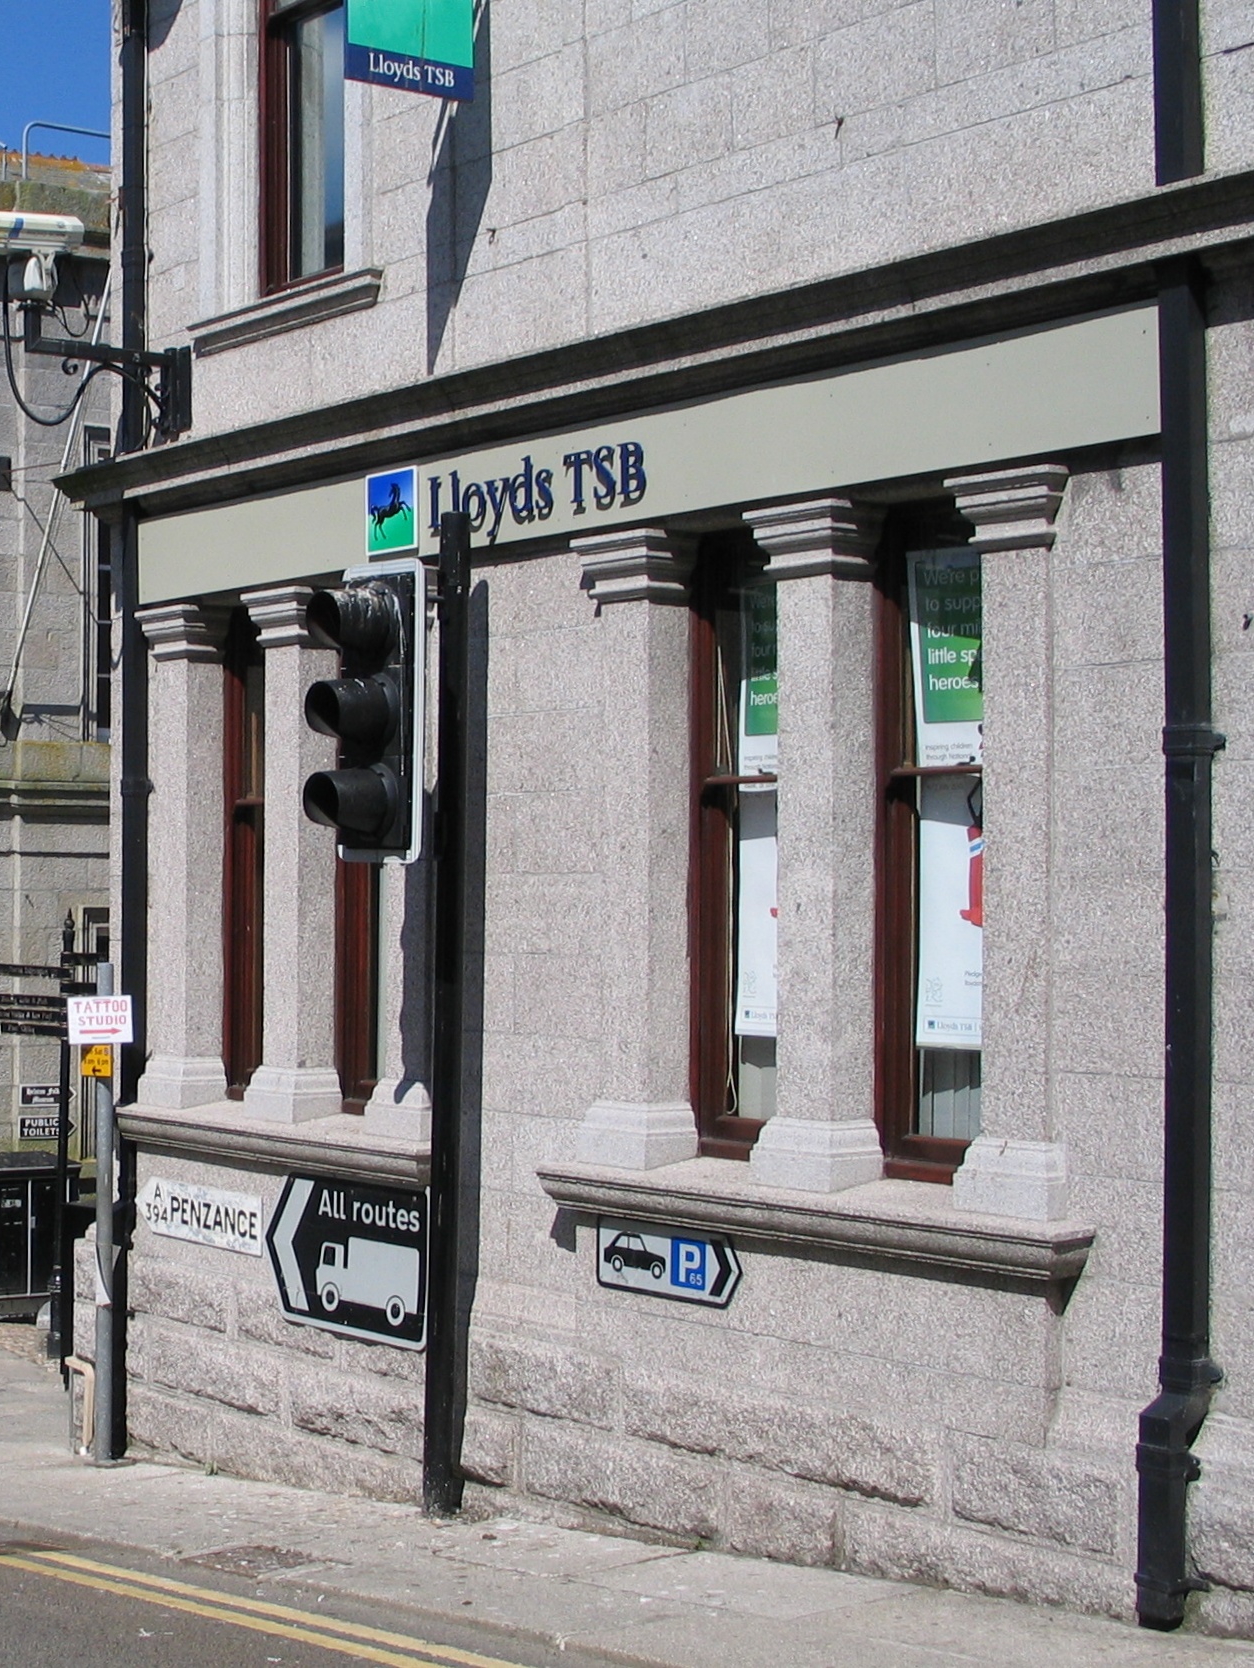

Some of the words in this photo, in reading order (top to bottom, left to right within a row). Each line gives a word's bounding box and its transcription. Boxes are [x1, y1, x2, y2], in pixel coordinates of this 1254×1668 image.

[368, 52, 421, 82] Lloyds
[424, 65, 455, 87] TSB
[428, 455, 553, 539] Lloyds
[562, 441, 646, 506] TSB
[926, 621, 954, 639] four
[927, 646, 956, 665] little
[929, 673, 980, 691] heroes
[73, 999, 128, 1014] TATTOO
[78, 1014, 127, 1026] STUDIO
[25, 1117, 59, 1127] PUBLIC
[154, 1182, 162, 1201] A
[145, 1202, 168, 1224] 394
[170, 1195, 258, 1240] PENZANCE
[317, 1188, 346, 1220] All
[352, 1200, 421, 1232] routes
[678, 1243, 701, 1283] P
[689, 1272, 703, 1286] 65
